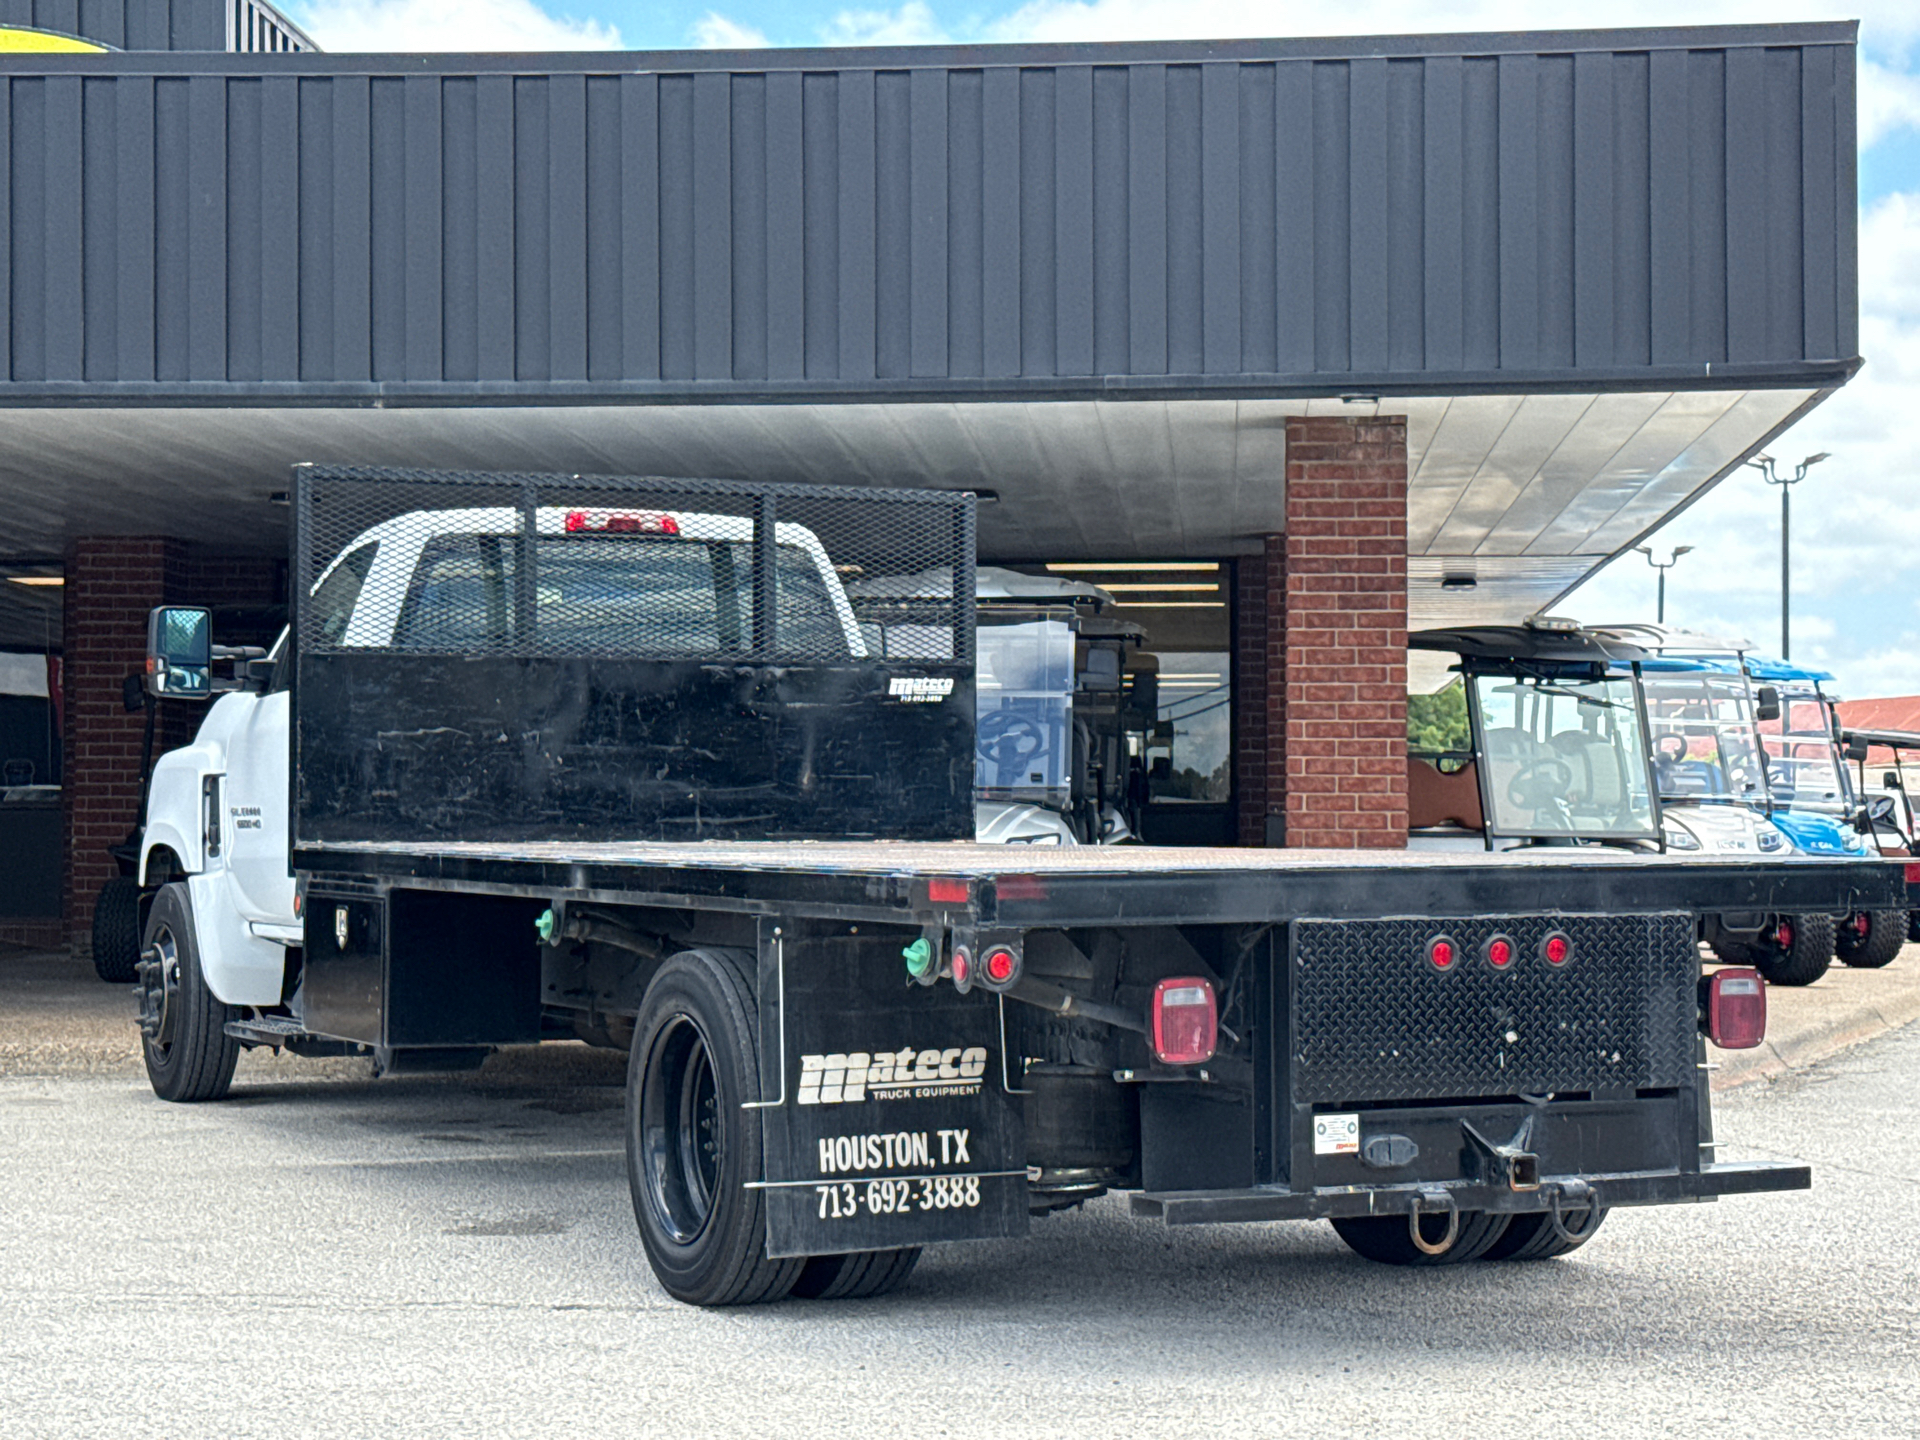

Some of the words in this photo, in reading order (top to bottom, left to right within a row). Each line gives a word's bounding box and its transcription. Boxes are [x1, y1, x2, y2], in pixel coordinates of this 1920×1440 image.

[798, 1046, 987, 1104] mateco
[873, 1090, 911, 1100] TRUCK
[915, 1085, 982, 1099] EQUIPMENT
[818, 1131, 936, 1173] HOUSTON,
[937, 1129, 970, 1164] TX
